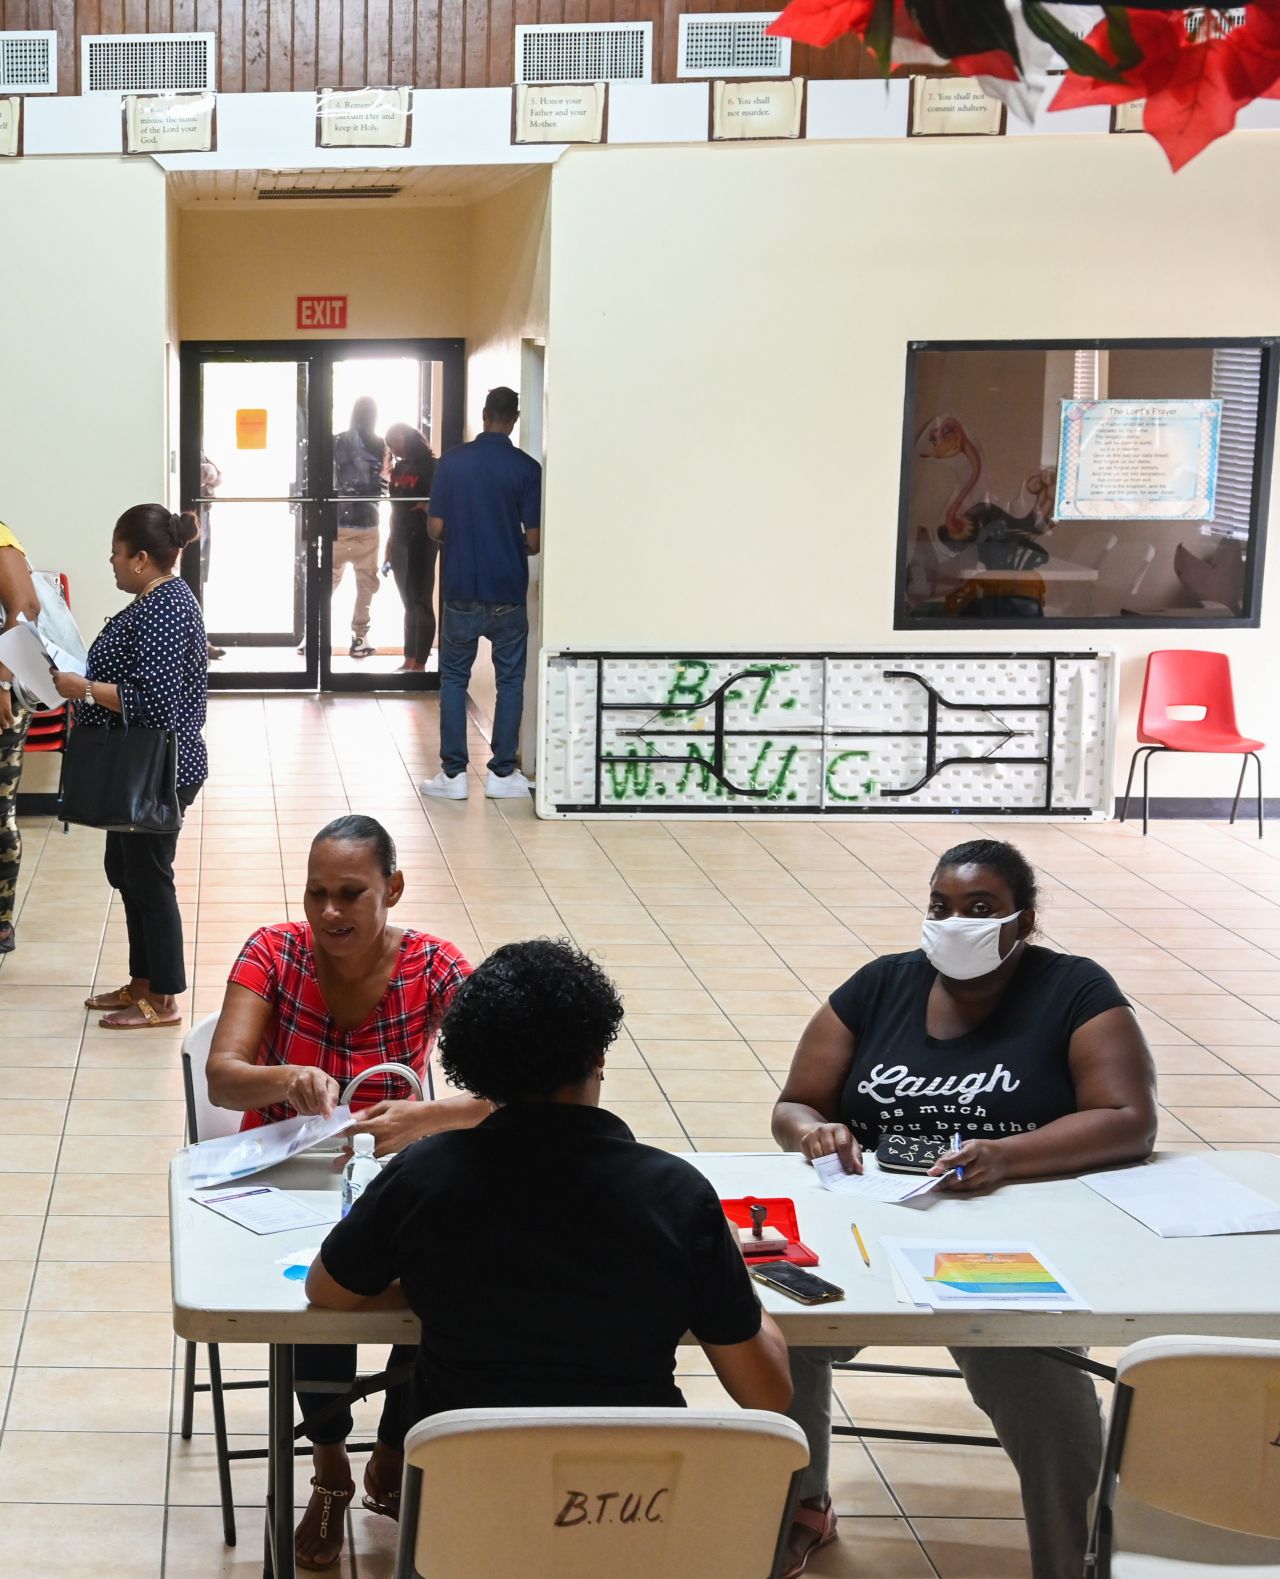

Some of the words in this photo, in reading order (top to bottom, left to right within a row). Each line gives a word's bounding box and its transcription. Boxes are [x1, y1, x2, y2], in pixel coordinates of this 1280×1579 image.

[737, 97, 751, 105] You
[753, 96, 770, 104] shall
[937, 92, 951, 101] You
[953, 92, 970, 100] shall
[540, 97, 563, 105] Honor
[565, 98, 582, 106] your
[530, 108, 552, 116] Father
[554, 108, 568, 116] and
[742, 108, 770, 116] murder.
[335, 124, 351, 132] keep
[529, 120, 558, 128] Mother.
[140, 126, 148, 134] of
[149, 126, 160, 134] the
[163, 125, 179, 133] Lord
[181, 126, 197, 134] your
[302, 300, 344, 325] EXIT
[1109, 407, 1123, 415] The
[1152, 408, 1177, 418] Prayer
[857, 1063, 1020, 1104] Laugh
[880, 1107, 904, 1120] as
[920, 1104, 987, 1118] much
[878, 1122, 921, 1133] you
[936, 1120, 1038, 1132] breathe
